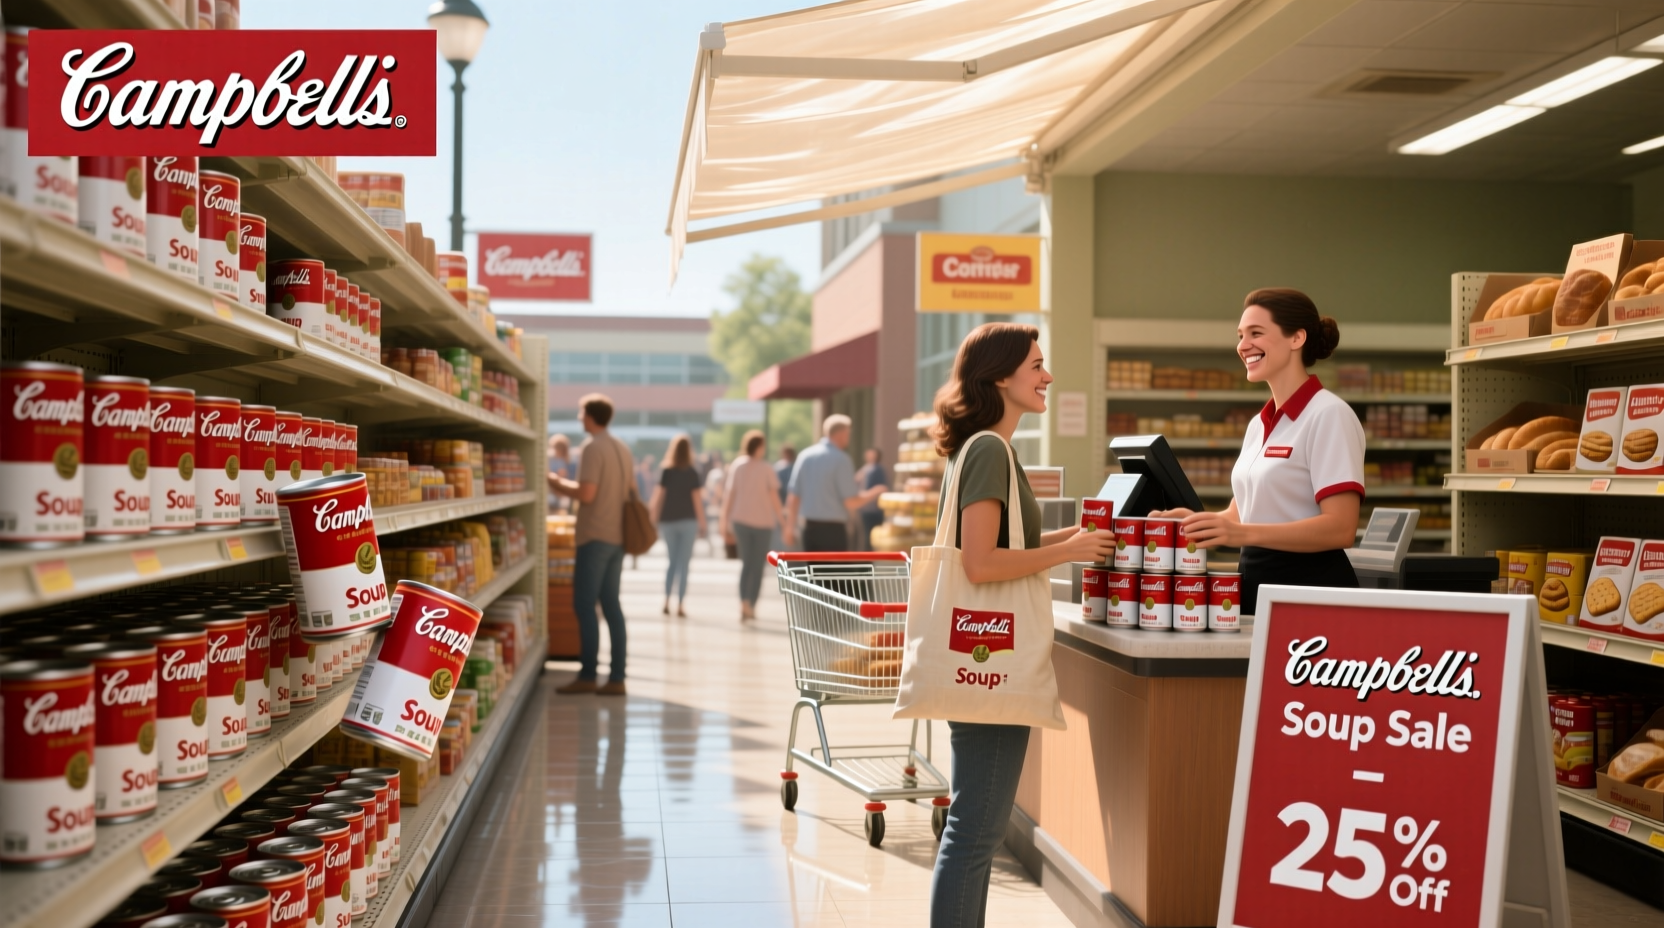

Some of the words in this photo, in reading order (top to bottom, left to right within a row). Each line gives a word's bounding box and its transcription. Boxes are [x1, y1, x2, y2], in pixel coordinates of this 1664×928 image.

[1281, 701, 1375, 751] Soup
[1386, 709, 1471, 753] Sale
[1389, 873, 1450, 913] Off
